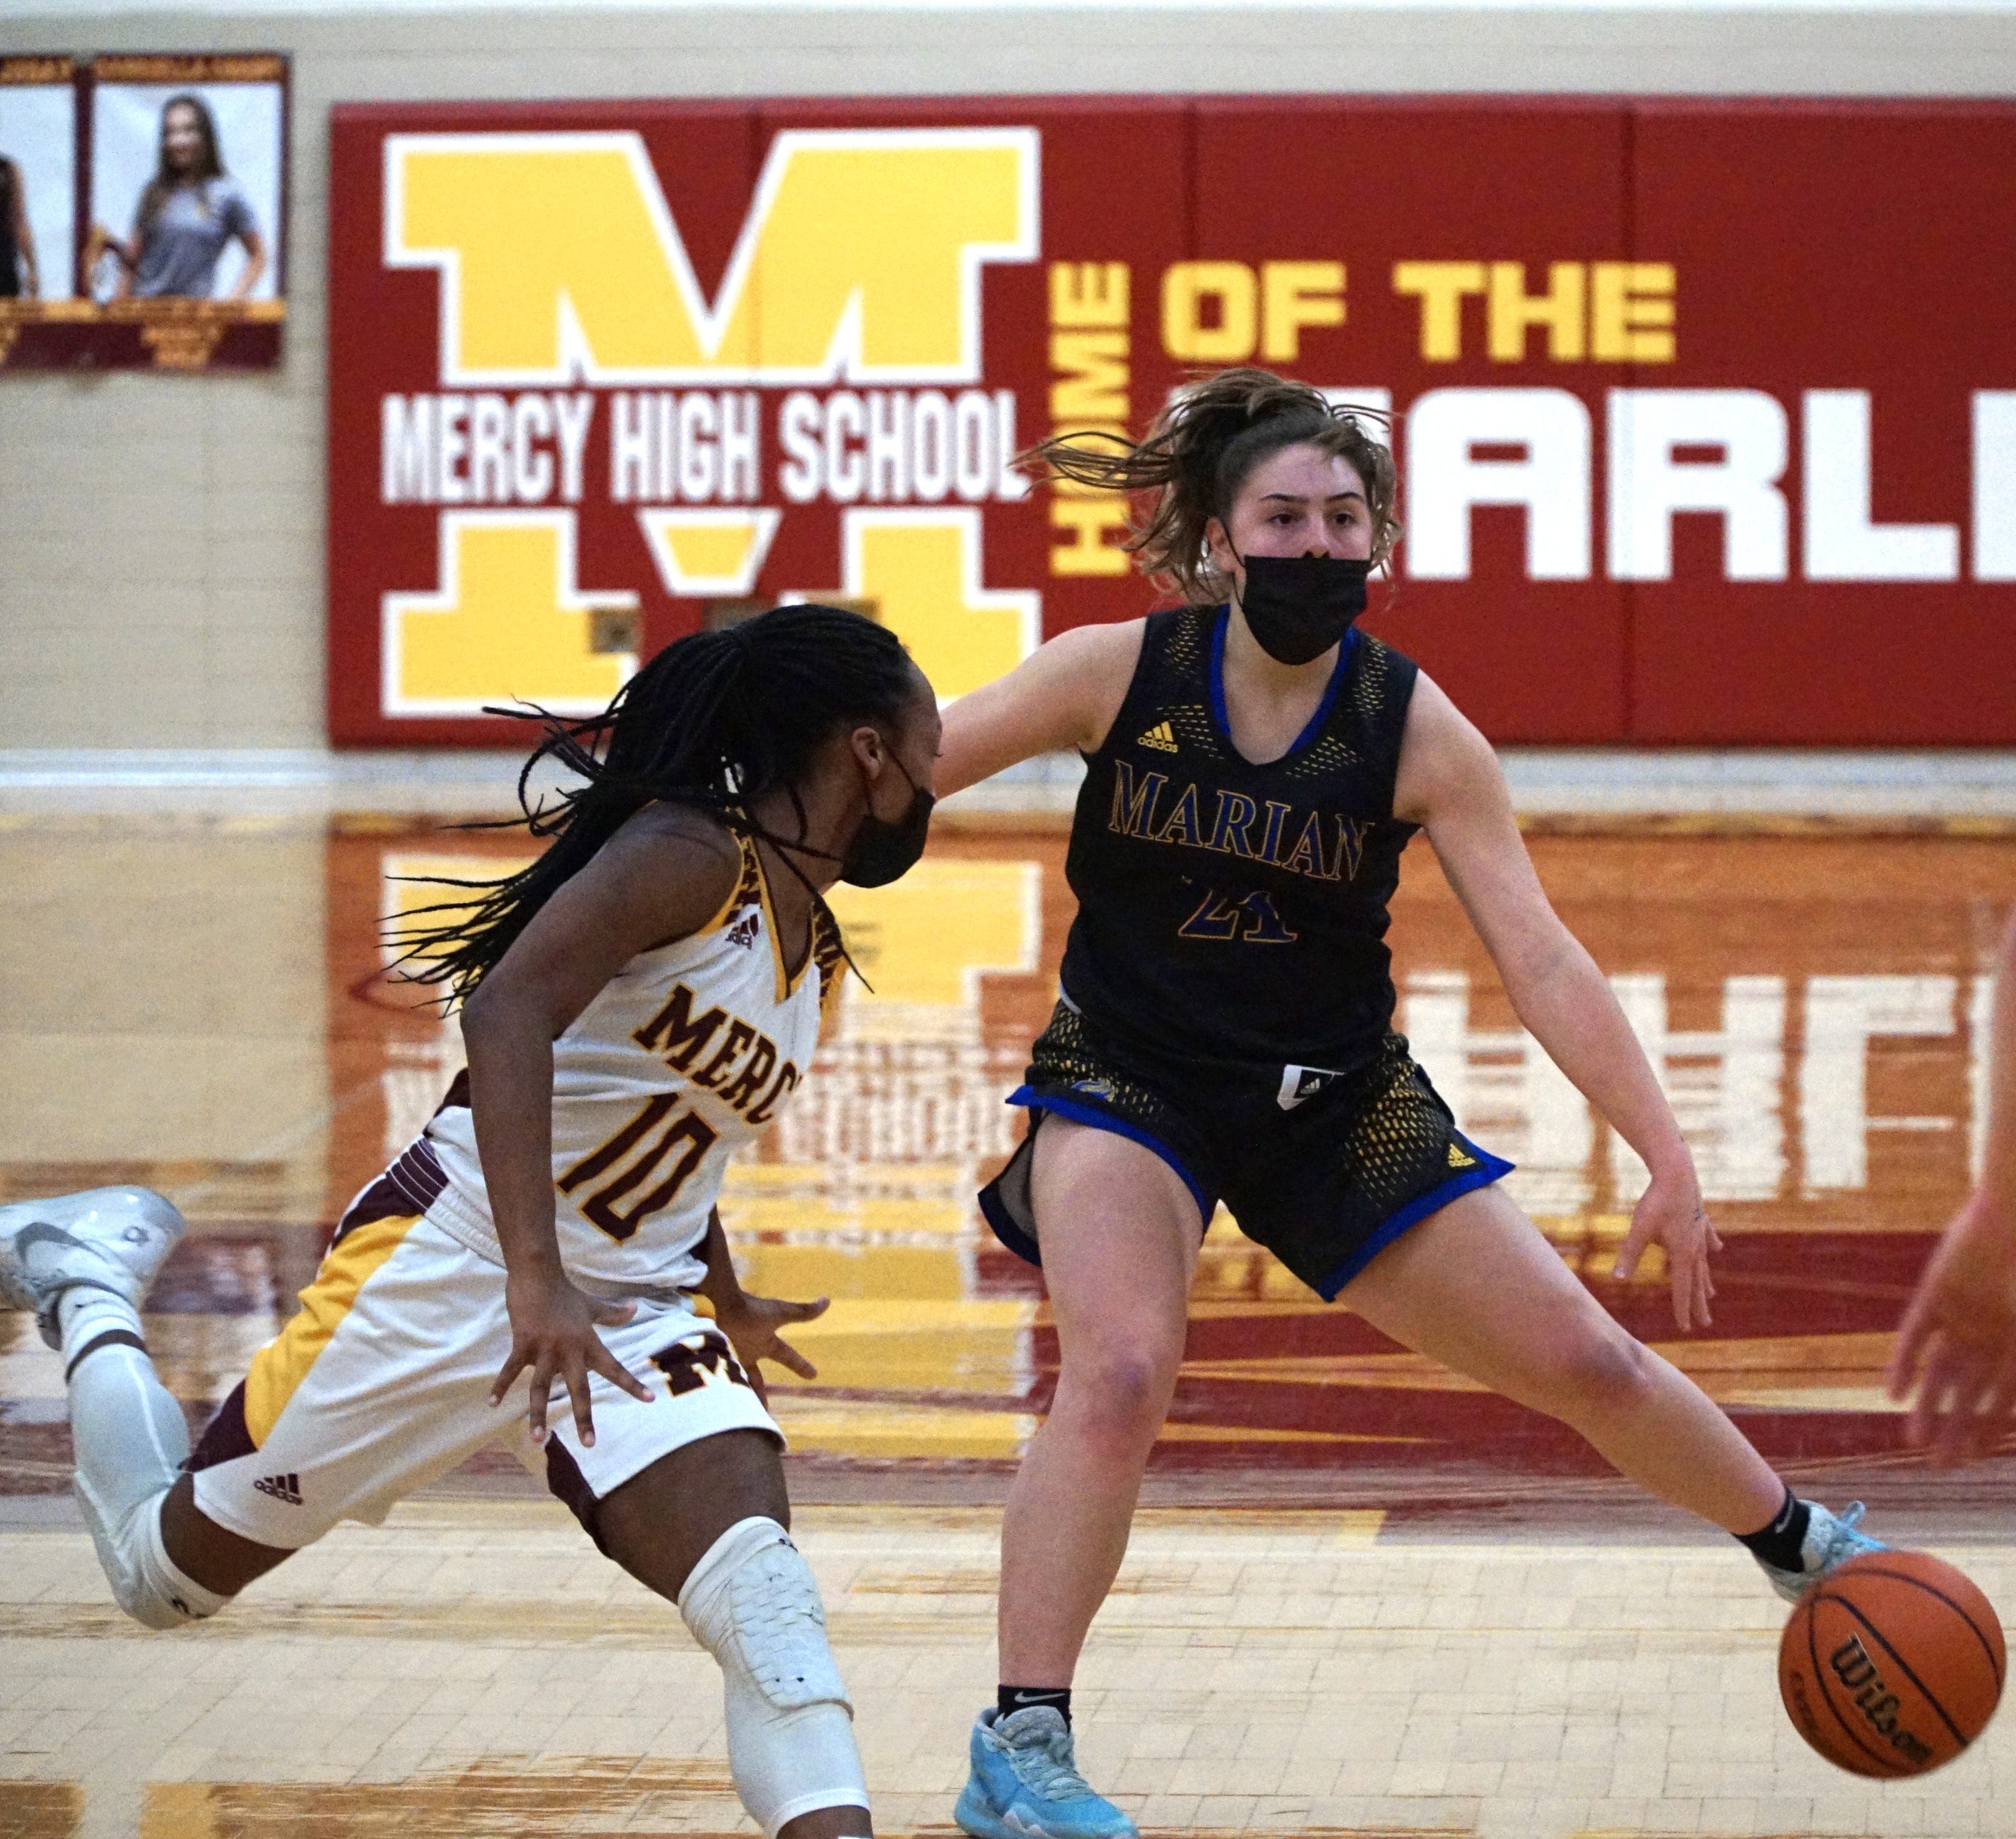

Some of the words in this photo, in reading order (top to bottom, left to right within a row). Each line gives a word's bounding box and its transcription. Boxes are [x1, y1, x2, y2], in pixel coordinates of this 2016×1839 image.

[1162, 261, 1347, 362] OF
[1393, 261, 1676, 362] THE
[382, 394, 592, 503] MERCY
[610, 394, 762, 503] HIGH
[779, 391, 1032, 503] SCHOOL
[1050, 262, 1132, 578] HOME
[1137, 736, 1179, 753] adidas
[1108, 759, 1375, 882] MARIAN
[631, 982, 803, 1125] MERC
[554, 1092, 719, 1247] 10
[253, 1479, 305, 1506] adidas
